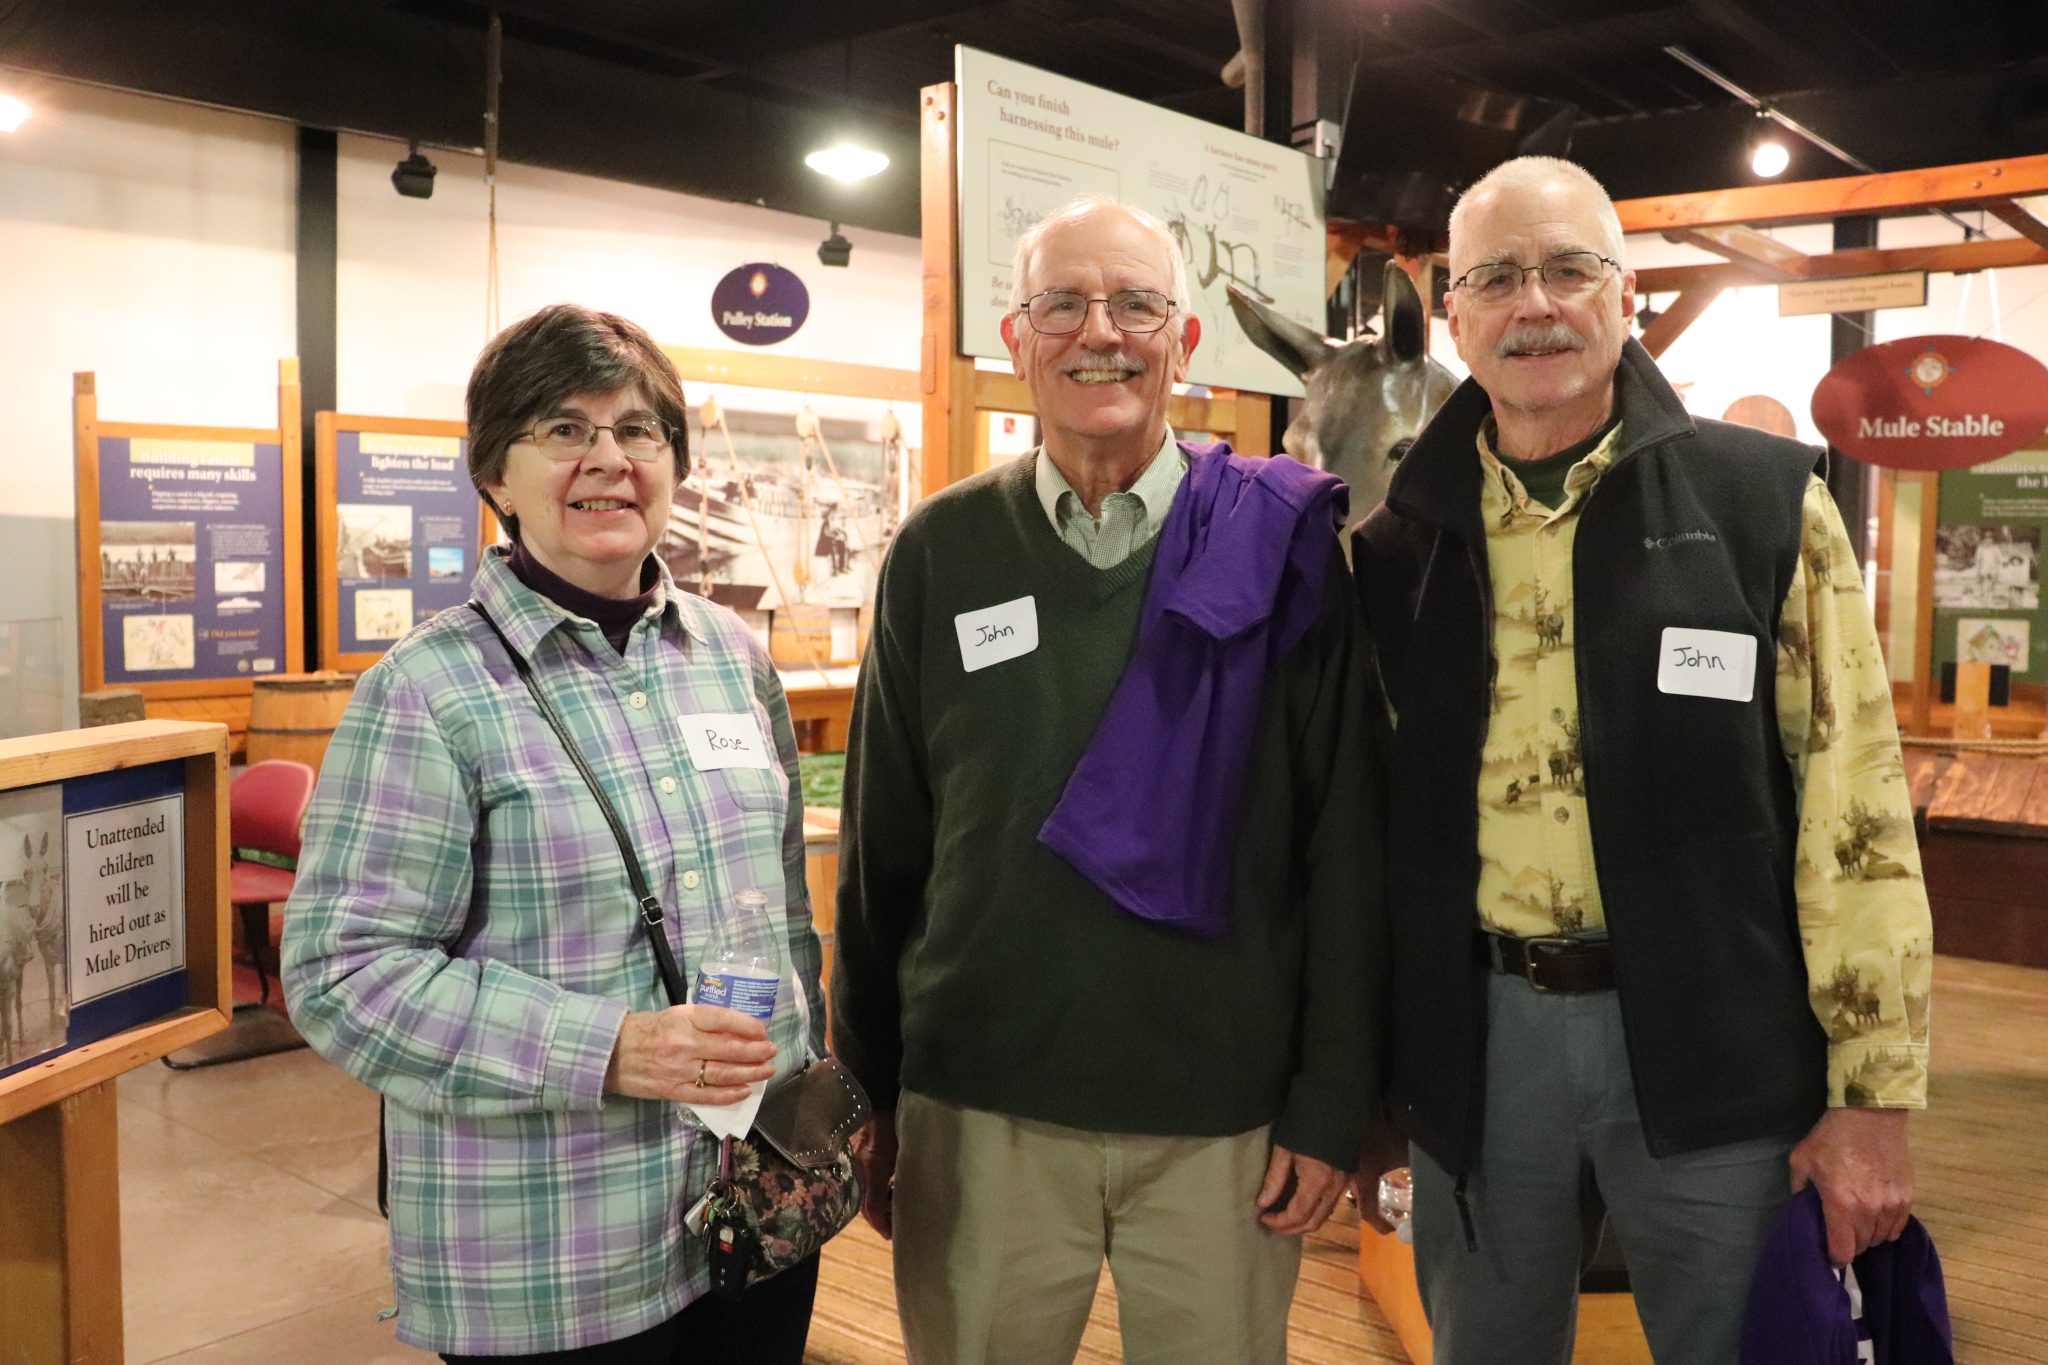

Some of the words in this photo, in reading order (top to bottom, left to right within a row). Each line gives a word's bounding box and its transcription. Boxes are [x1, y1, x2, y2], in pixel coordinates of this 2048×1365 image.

[987, 80, 1011, 99] Can
[1015, 90, 1035, 106] you
[1038, 94, 1070, 116] finish
[1000, 106, 1062, 141] harnessing
[1065, 125, 1085, 143] this
[1088, 135, 1120, 152] mule?
[723, 311, 754, 330] Pulley
[754, 312, 792, 328] Station
[1857, 416, 1921, 439] Mule
[1925, 414, 2004, 438] Stable
[130, 465, 186, 482] requires
[187, 469, 222, 484] many
[224, 467, 257, 482] skills
[371, 455, 410, 472] lighten
[412, 456, 429, 470] the
[431, 457, 454, 472] load
[2016, 475, 2040, 489] the
[1656, 529, 1716, 549] Columbia
[975, 625, 1015, 647] John
[1673, 646, 1726, 671] John
[705, 729, 750, 751] Rose
[86, 814, 165, 849] Unattended
[99, 852, 154, 878] children
[106, 883, 130, 907] will
[134, 881, 149, 900] be
[89, 915, 125, 944] hired
[129, 913, 150, 932] out
[154, 909, 166, 924] as
[86, 950, 121, 977] Mule
[124, 937, 171, 964] Drivers
[700, 983, 727, 997] purified
